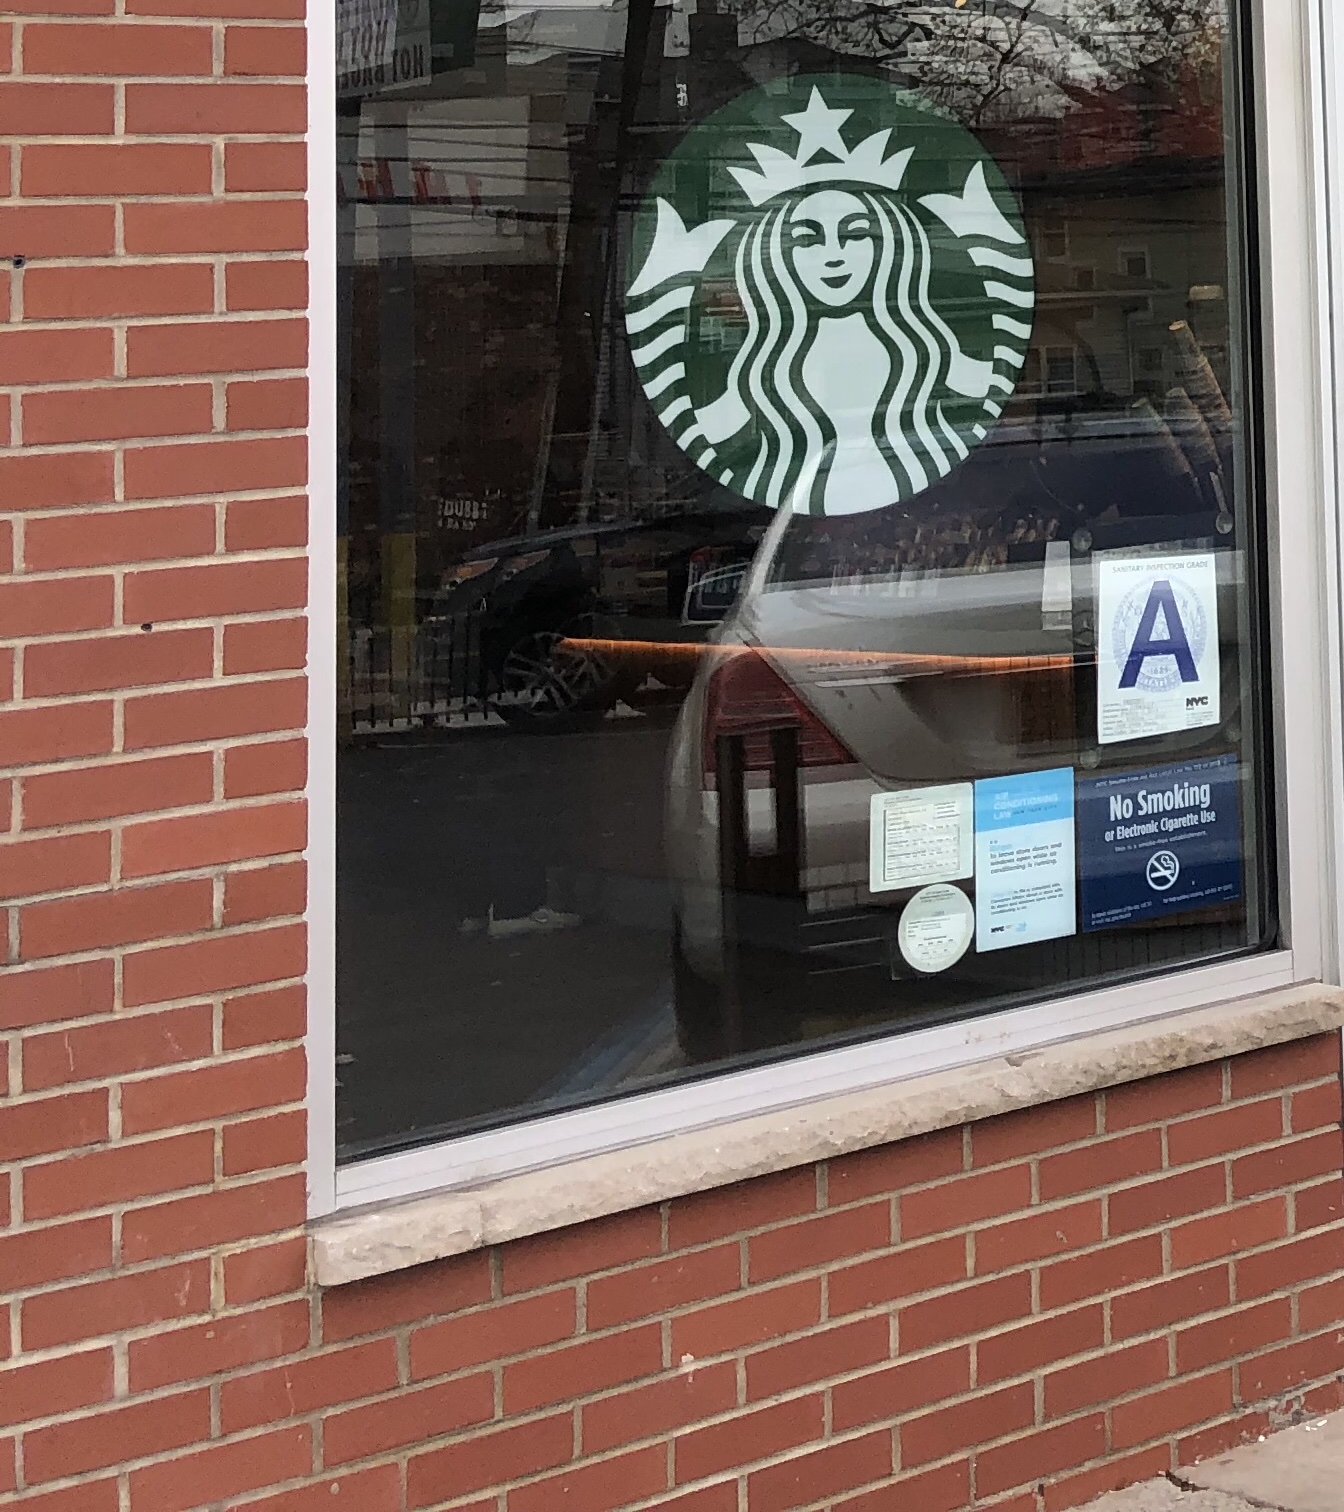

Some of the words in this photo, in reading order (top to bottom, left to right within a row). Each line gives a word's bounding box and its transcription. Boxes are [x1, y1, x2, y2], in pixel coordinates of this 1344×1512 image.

[1186, 560, 1209, 569] GRADE
[1118, 580, 1200, 689] A
[1185, 696, 1209, 707] NYC
[1109, 794, 1133, 821] No
[1137, 782, 1211, 816] Smoking
[1104, 830, 1116, 842] or
[1116, 819, 1159, 840] Electronic
[1160, 812, 1199, 833] Cigarette
[1200, 809, 1216, 823] Use
